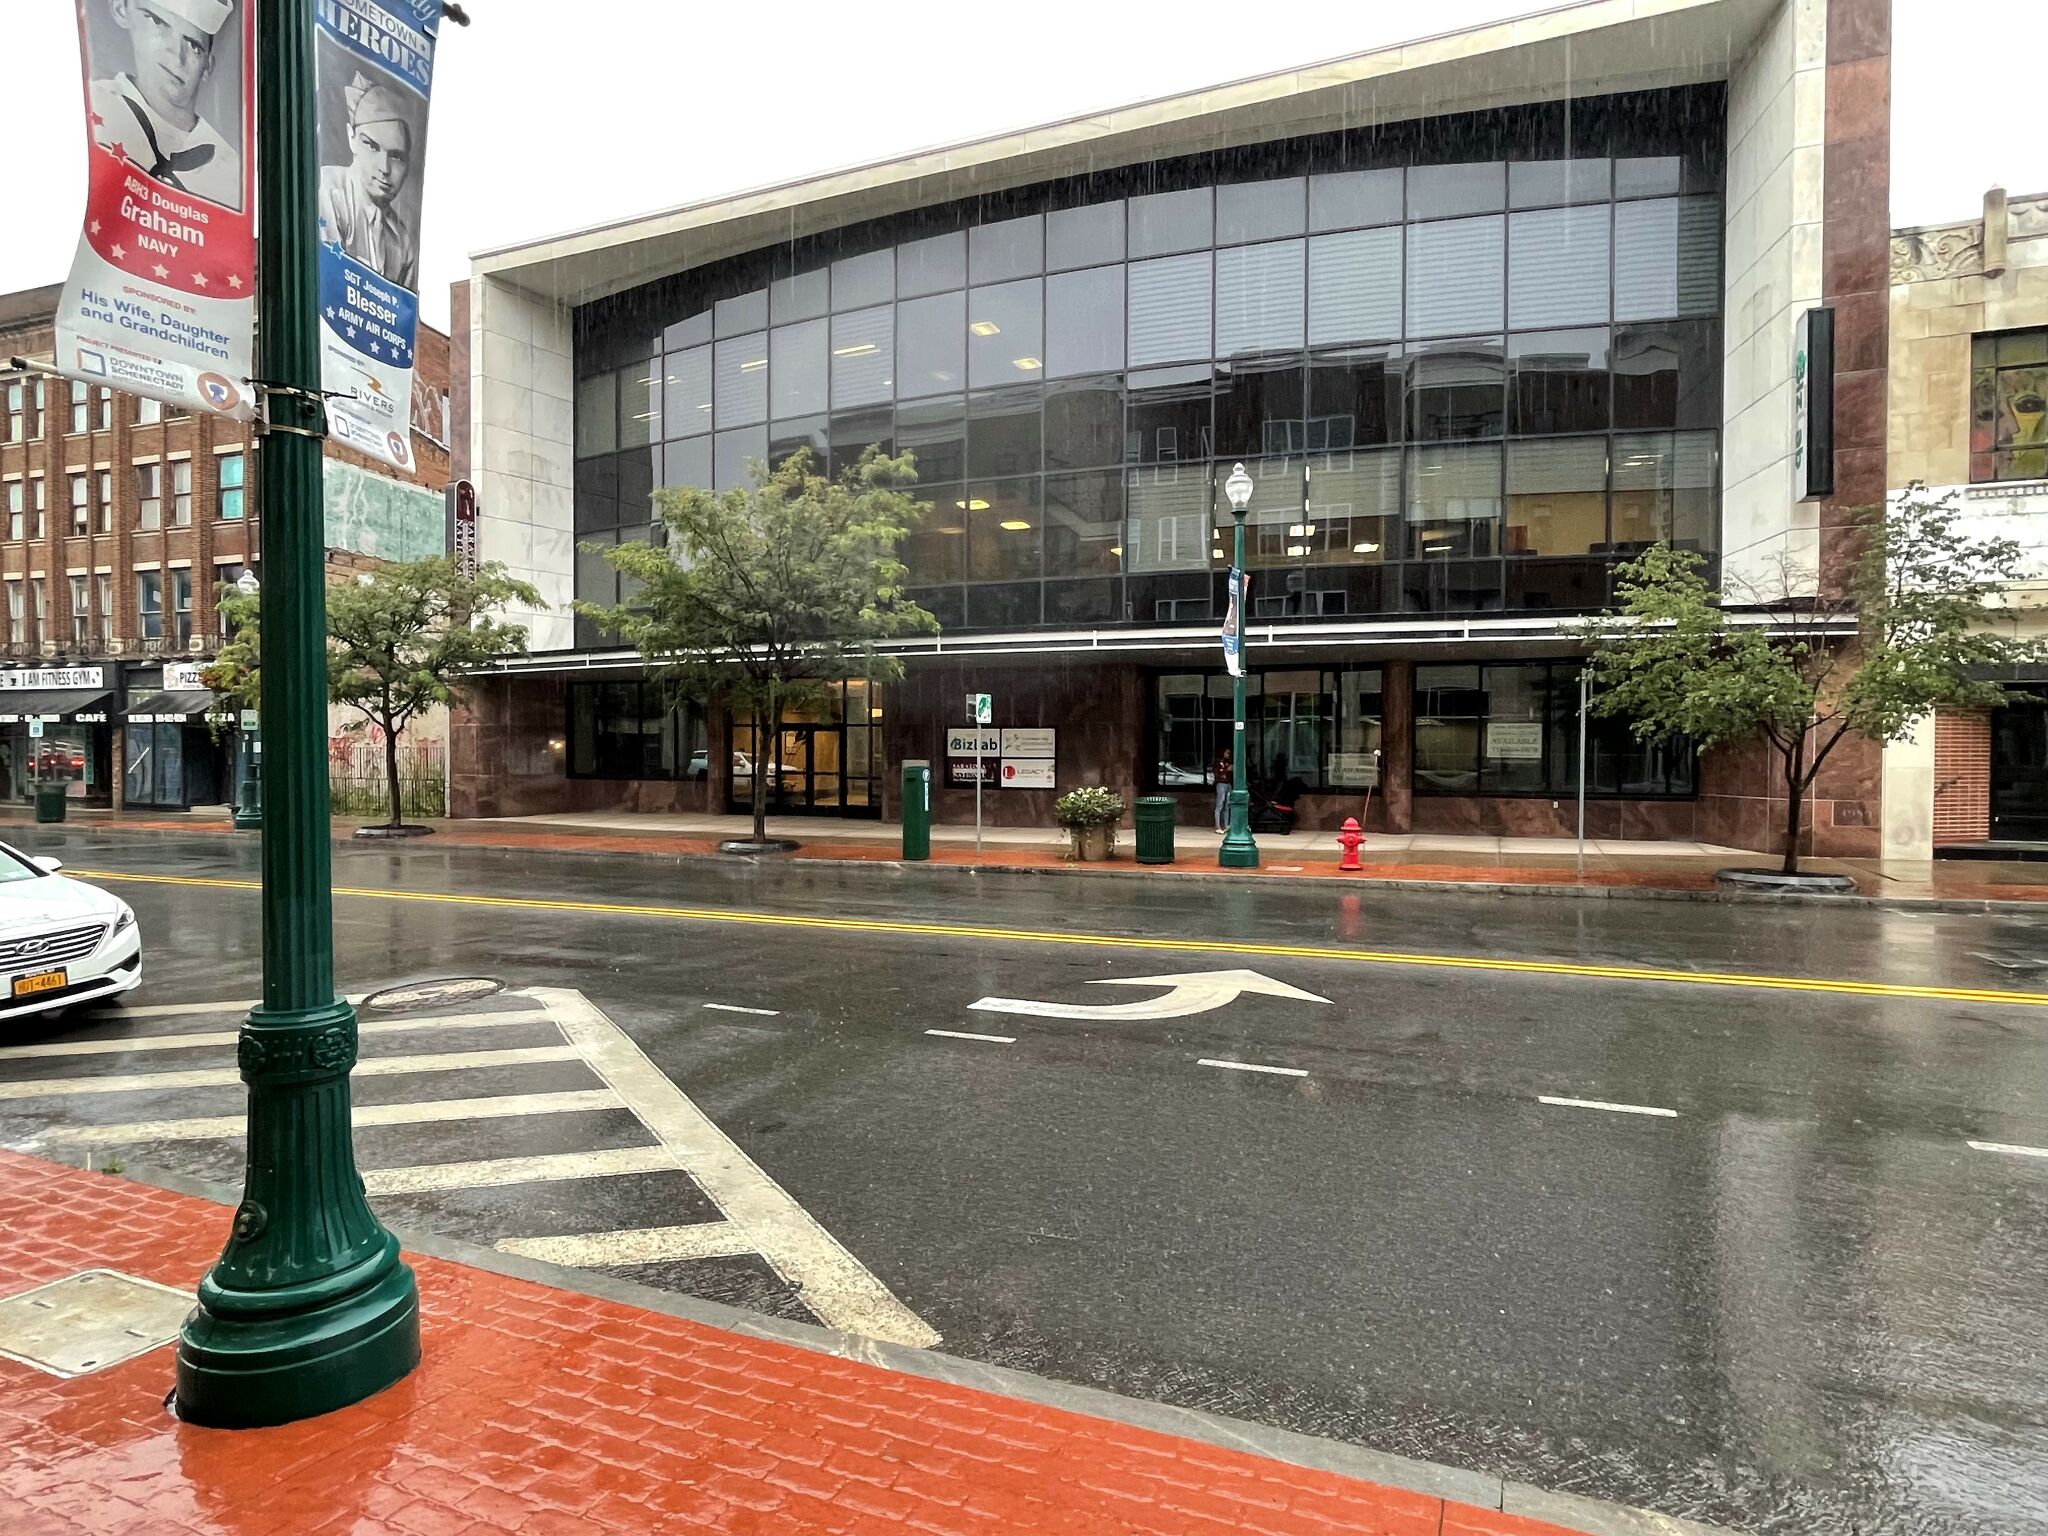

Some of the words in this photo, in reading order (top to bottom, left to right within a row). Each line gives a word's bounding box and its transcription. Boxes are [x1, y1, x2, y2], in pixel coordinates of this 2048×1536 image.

[341, 0, 417, 47] OMETOWN
[318, 0, 430, 85] HEROES
[121, 195, 204, 247] Graham
[152, 191, 209, 224] Douglas
[138, 234, 178, 258] NAVY
[122, 286, 181, 310] SPONSORED
[344, 268, 361, 286] SGT
[363, 280, 391, 302] Joseph
[81, 288, 108, 308] His
[113, 298, 155, 323] Wife,
[160, 313, 230, 345] Daughter
[346, 285, 397, 326] Blesser
[81, 306, 113, 324] and
[119, 316, 229, 360] Grandchildren
[338, 307, 364, 328] ARMY
[365, 320, 380, 336] AIR
[382, 328, 406, 349] CORPS
[110, 357, 184, 383] DOWNTOWN
[111, 366, 184, 390] SCHENECTADY
[350, 386, 394, 413] RIVERS
[22, 673, 25, 687] I
[28, 672, 40, 686] AM
[41, 671, 71, 686] FITNESS
[72, 670, 91, 686] GYM
[180, 672, 199, 683] PIZZ
